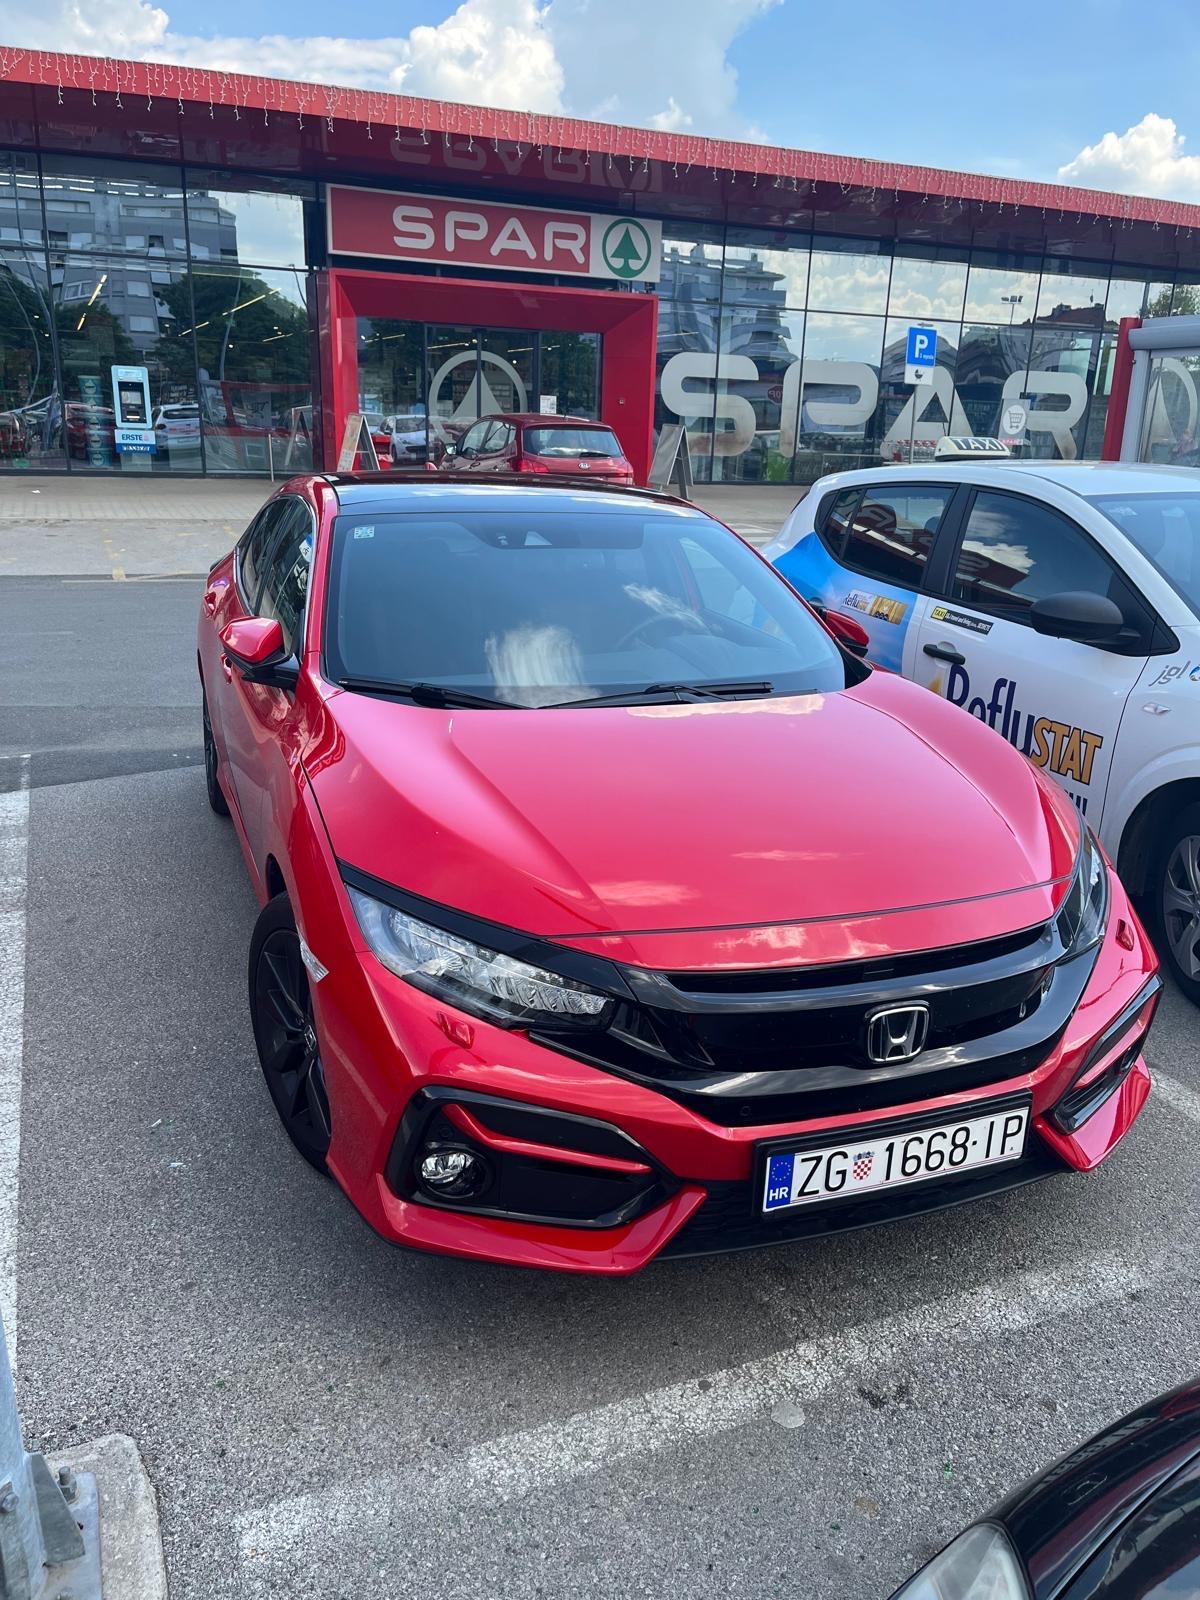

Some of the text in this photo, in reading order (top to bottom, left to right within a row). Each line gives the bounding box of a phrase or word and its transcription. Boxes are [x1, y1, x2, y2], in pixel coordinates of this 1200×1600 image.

[393, 205, 587, 265] SPAR
[915, 334, 929, 358] P
[661, 352, 1087, 459] SPAR
[121, 433, 143, 441] ERSTE
[951, 438, 1003, 450] TAXI
[1148, 660, 1191, 687] jgl
[769, 1186, 789, 1201] HR
[797, 1150, 849, 1198] ZG
